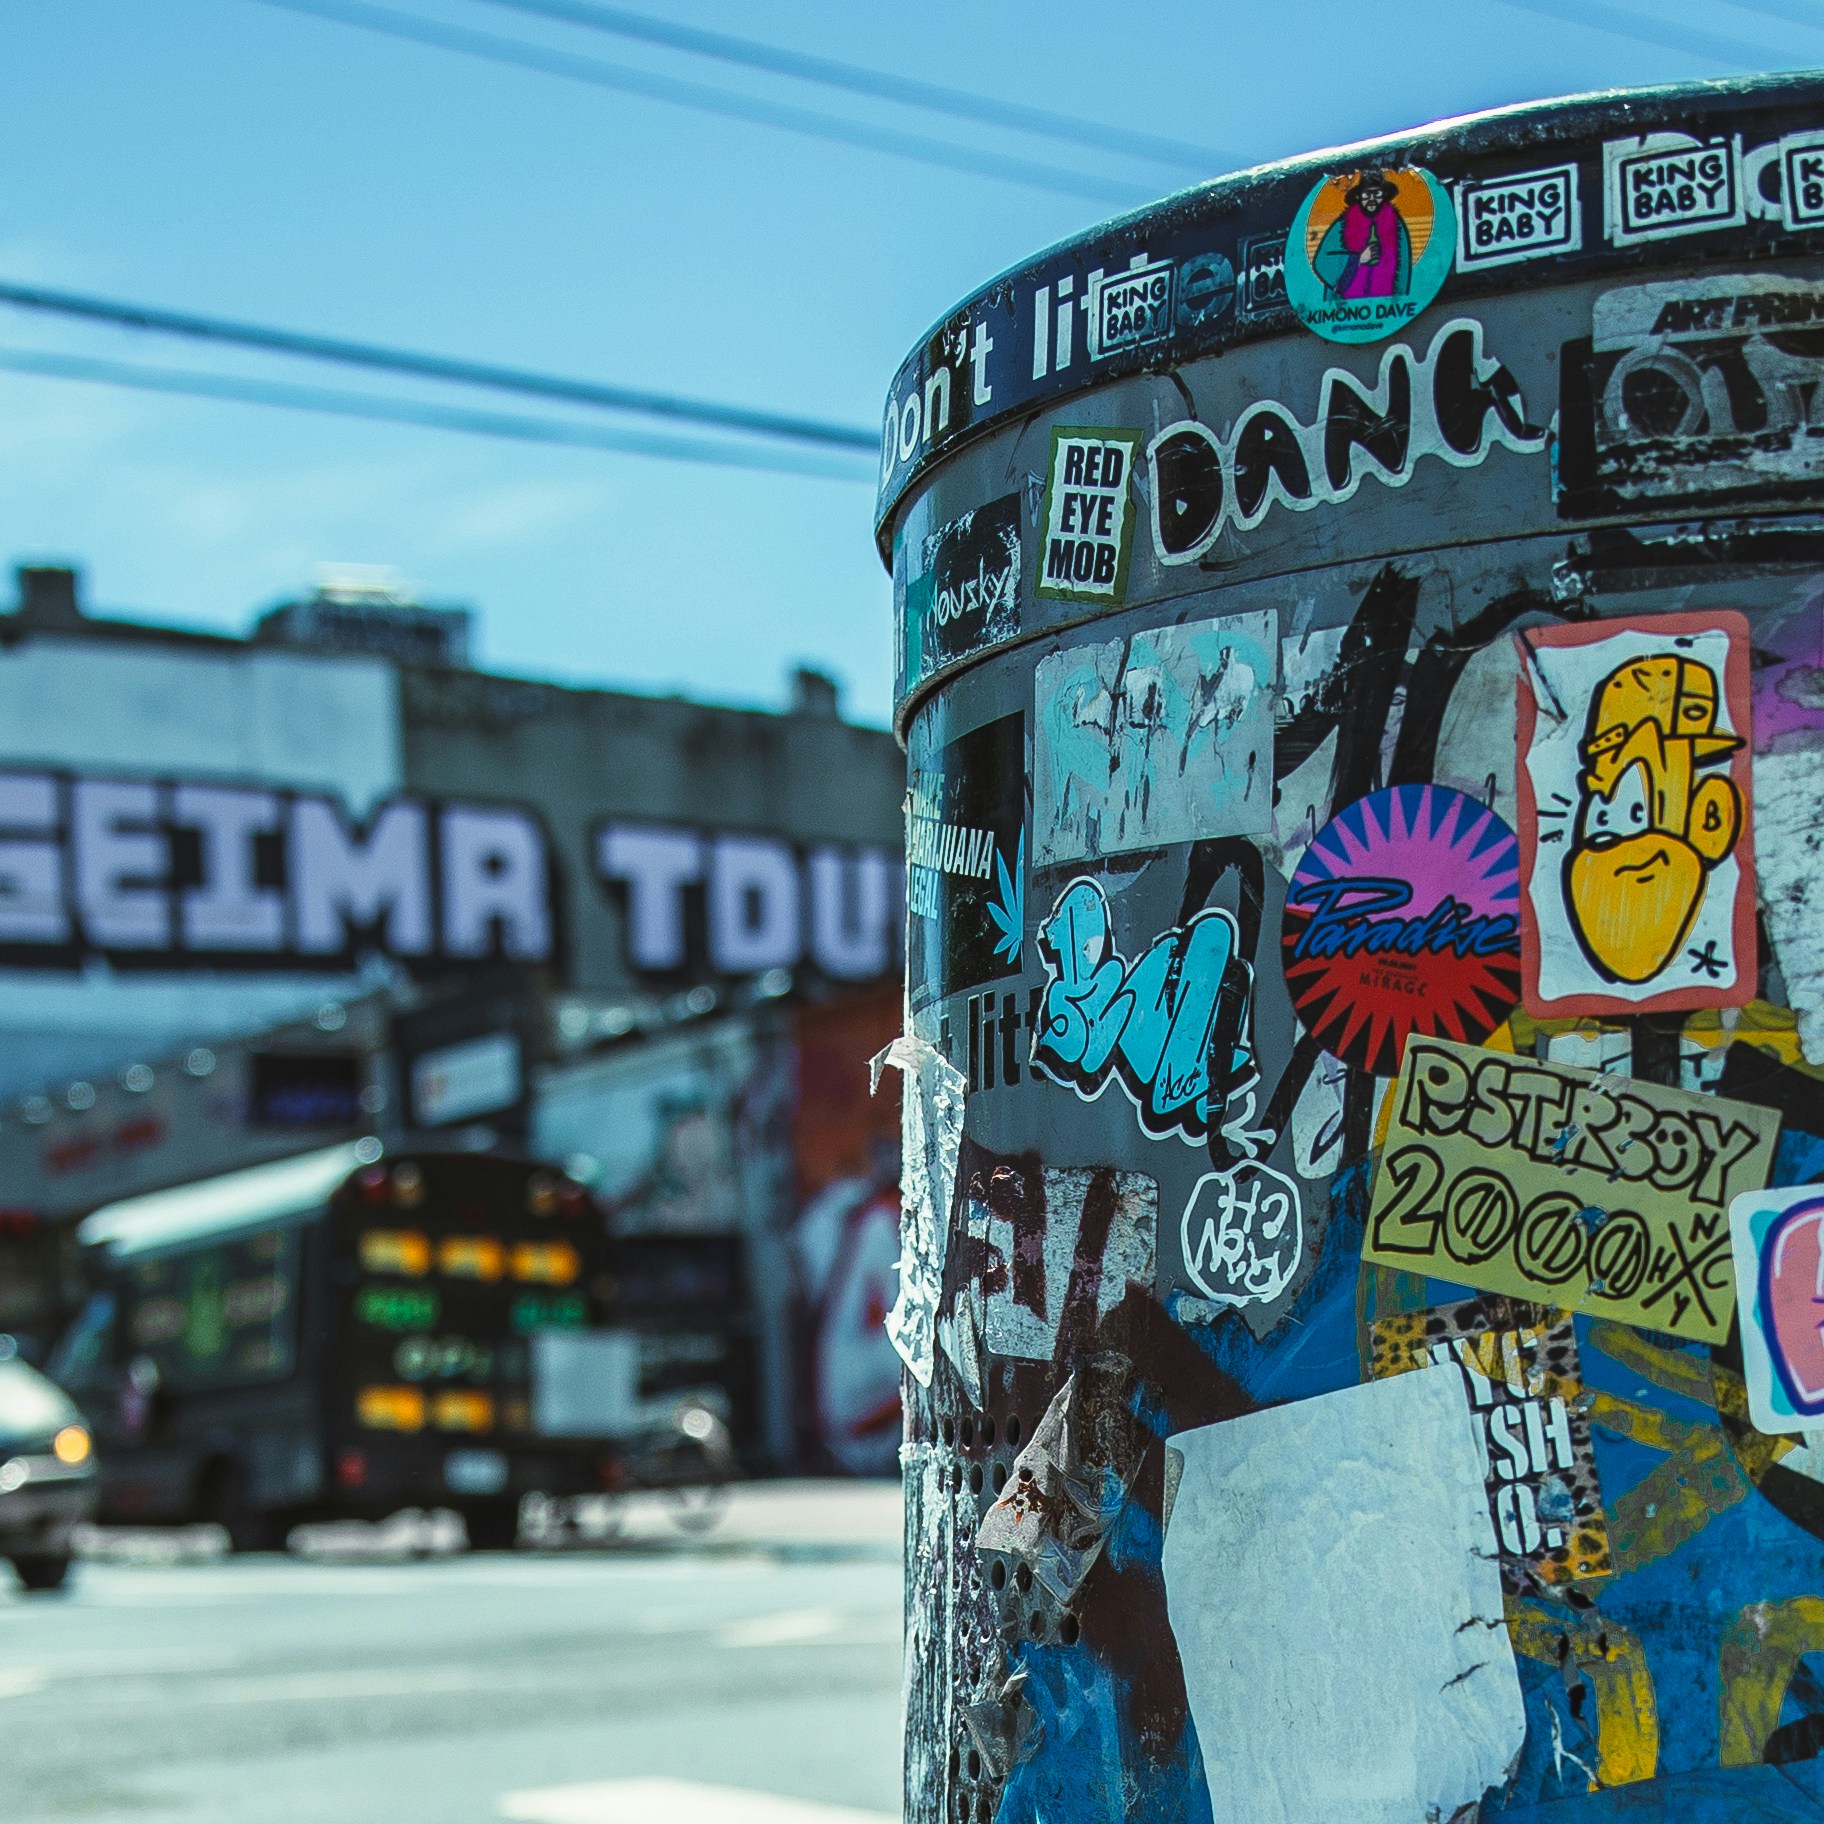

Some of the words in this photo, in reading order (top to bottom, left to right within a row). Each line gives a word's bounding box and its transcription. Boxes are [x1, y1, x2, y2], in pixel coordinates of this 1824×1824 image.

[1633, 154, 1723, 194] KING
[1474, 181, 1562, 221] KING
[1633, 180, 1726, 219] BABY
[1474, 206, 1563, 247] BABY
[1107, 276, 1167, 314] KING
[1307, 305, 1372, 325] KIMONO
[1376, 302, 1418, 319] DAVE
[1107, 300, 1167, 341] BABY
[1063, 445, 1125, 489] RED
[1059, 492, 1116, 537] EYE
[1046, 538, 1117, 585] MOB
[910, 864, 939, 920] LEGAL
[1295, 877, 1521, 959] Paradise
